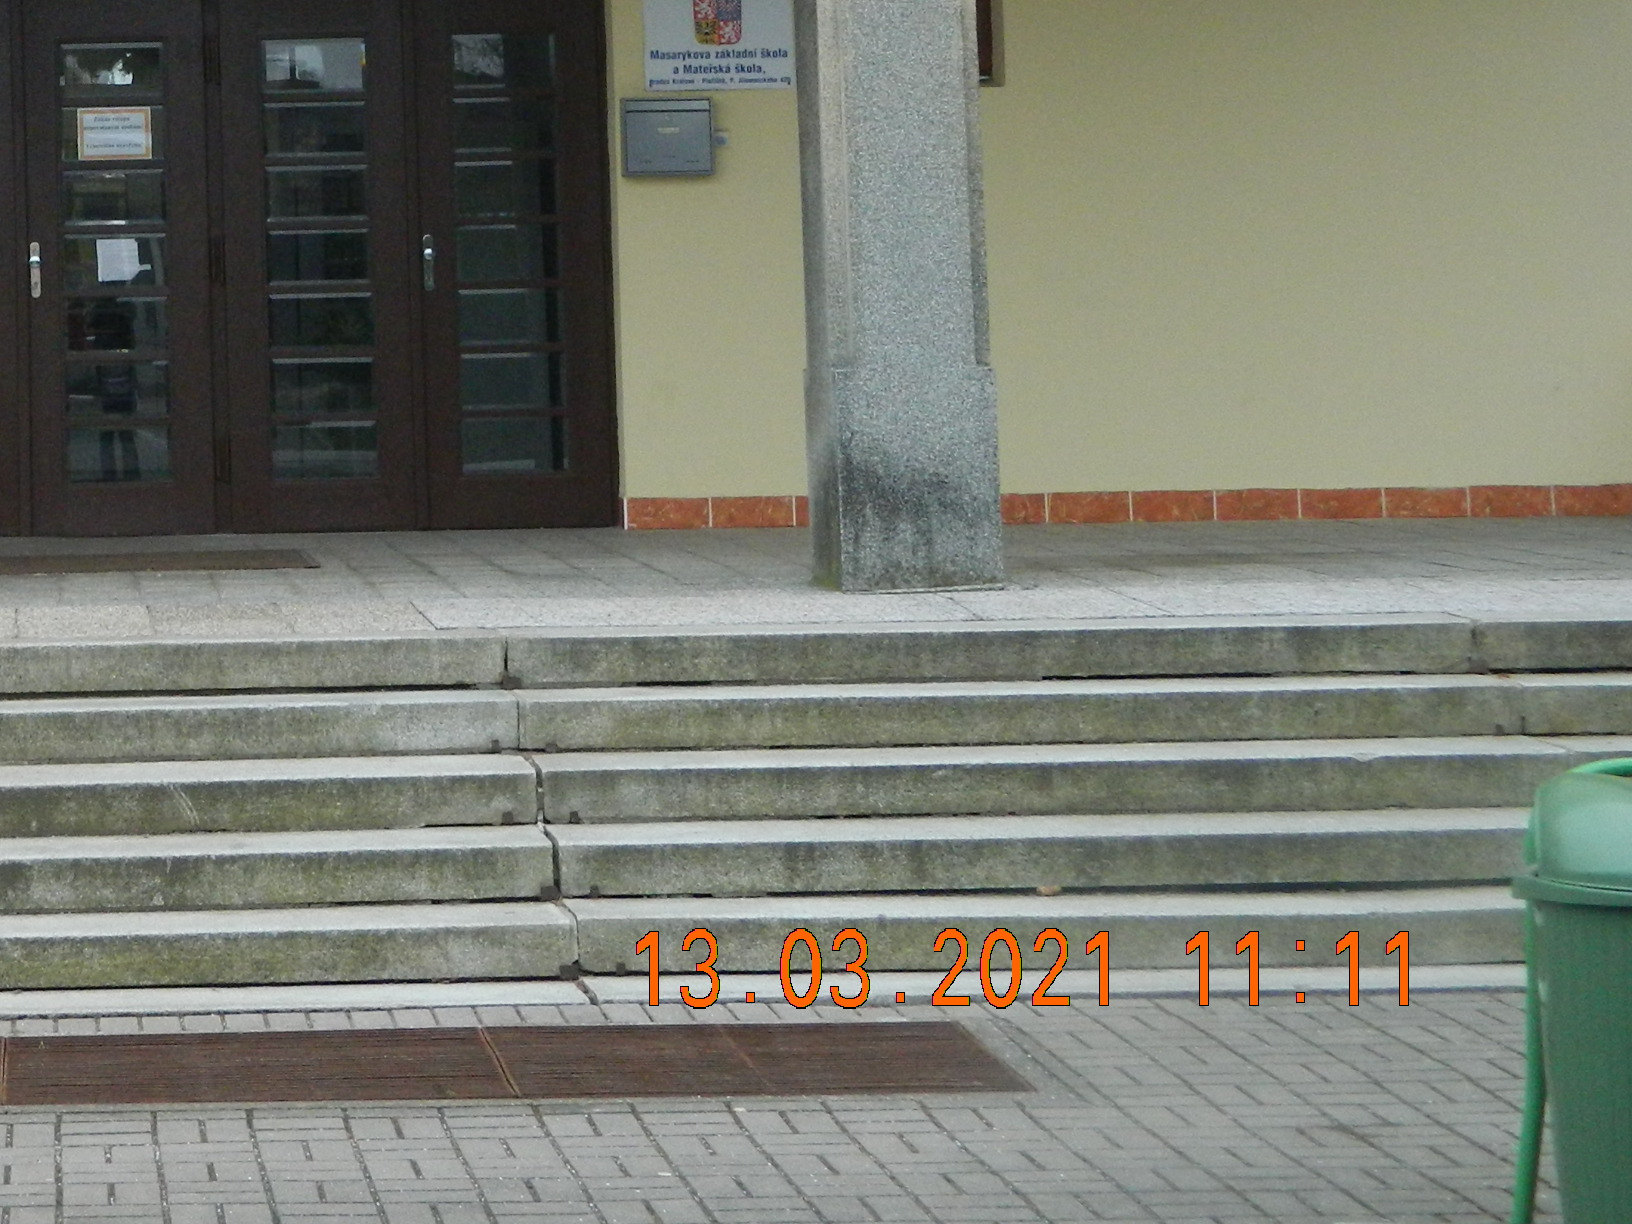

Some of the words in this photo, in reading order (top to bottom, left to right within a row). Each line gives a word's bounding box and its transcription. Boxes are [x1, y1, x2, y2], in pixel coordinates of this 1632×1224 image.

[649, 50, 712, 61] Masarykova
[714, 48, 758, 59] základní
[760, 48, 789, 58] škola
[672, 66, 680, 75] a
[682, 63, 732, 75] Mateřská
